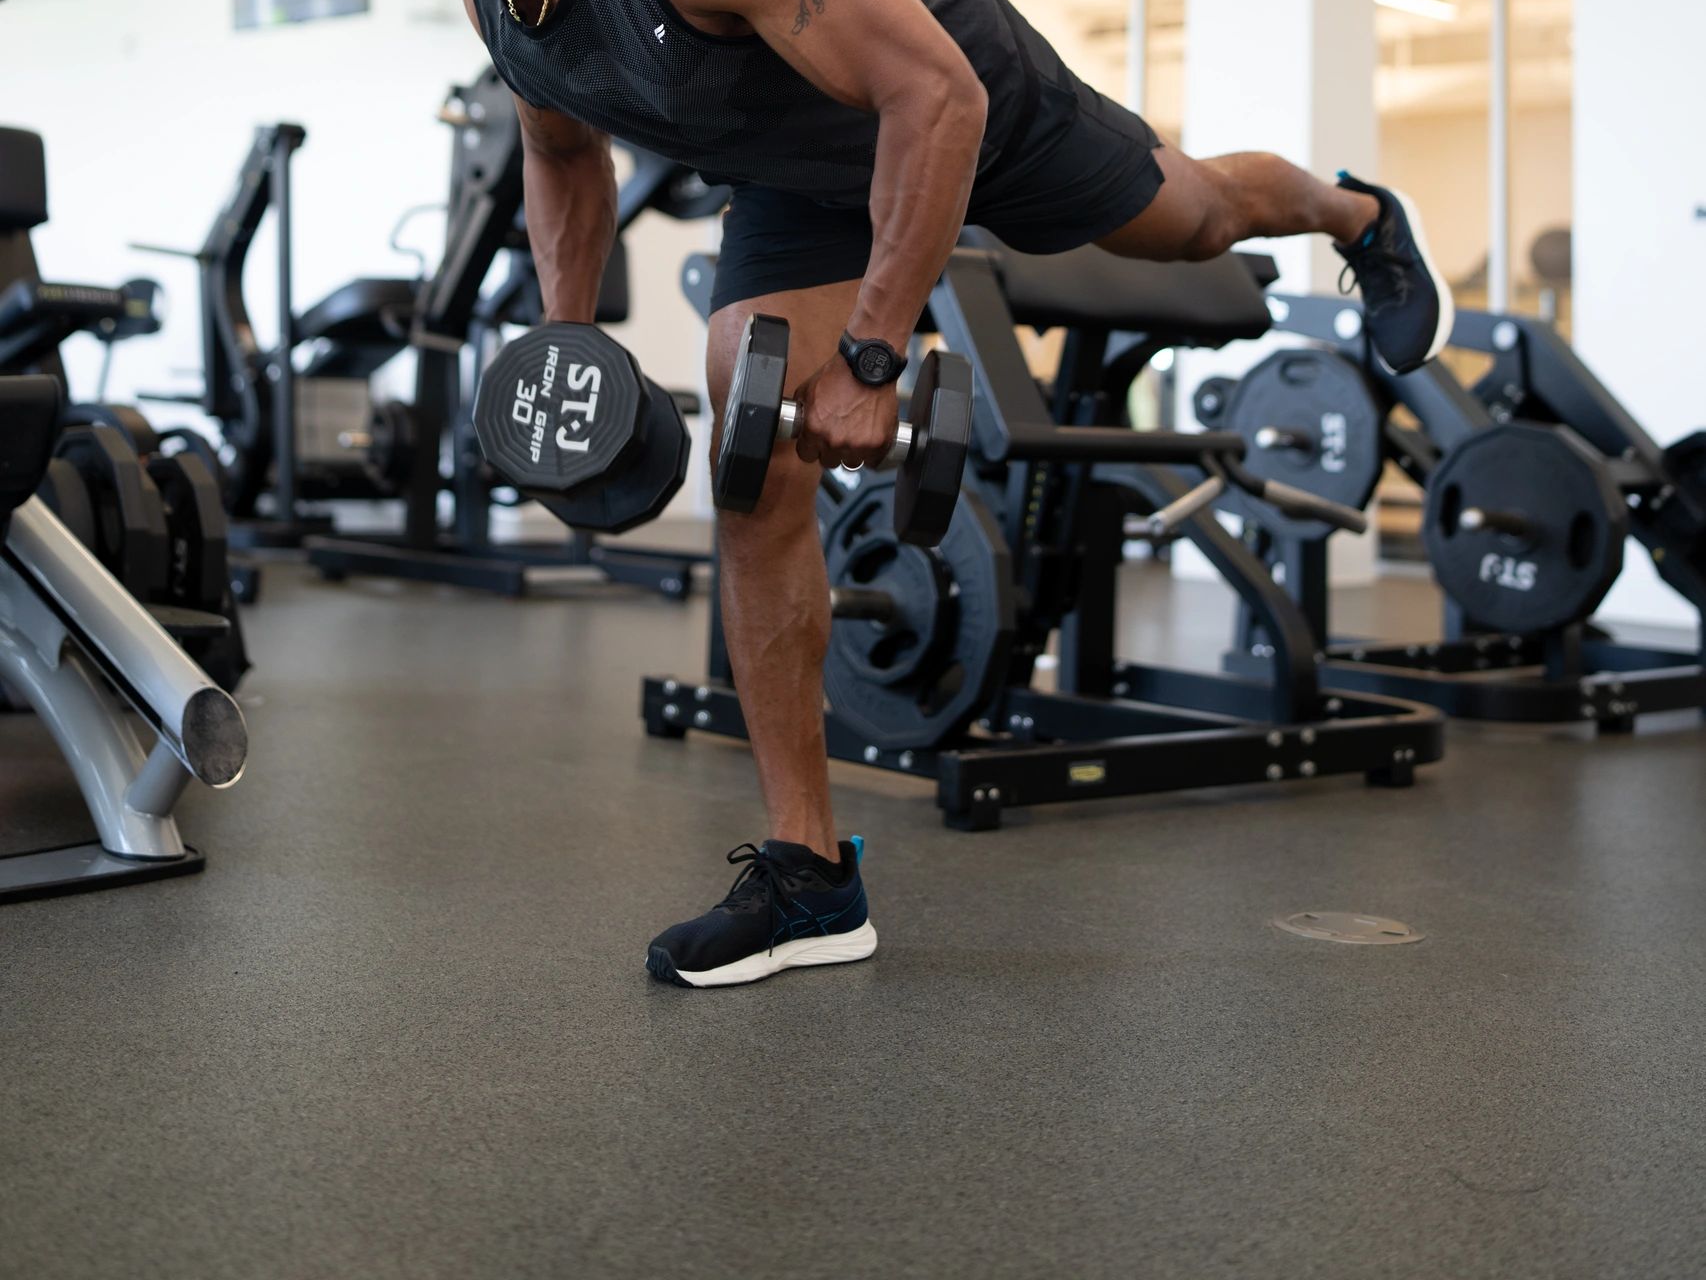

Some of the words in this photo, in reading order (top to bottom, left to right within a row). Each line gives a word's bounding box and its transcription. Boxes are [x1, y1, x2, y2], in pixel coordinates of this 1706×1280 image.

[540, 344, 560, 398] IRON
[512, 378, 537, 424] 30
[529, 410, 548, 464] GRIP
